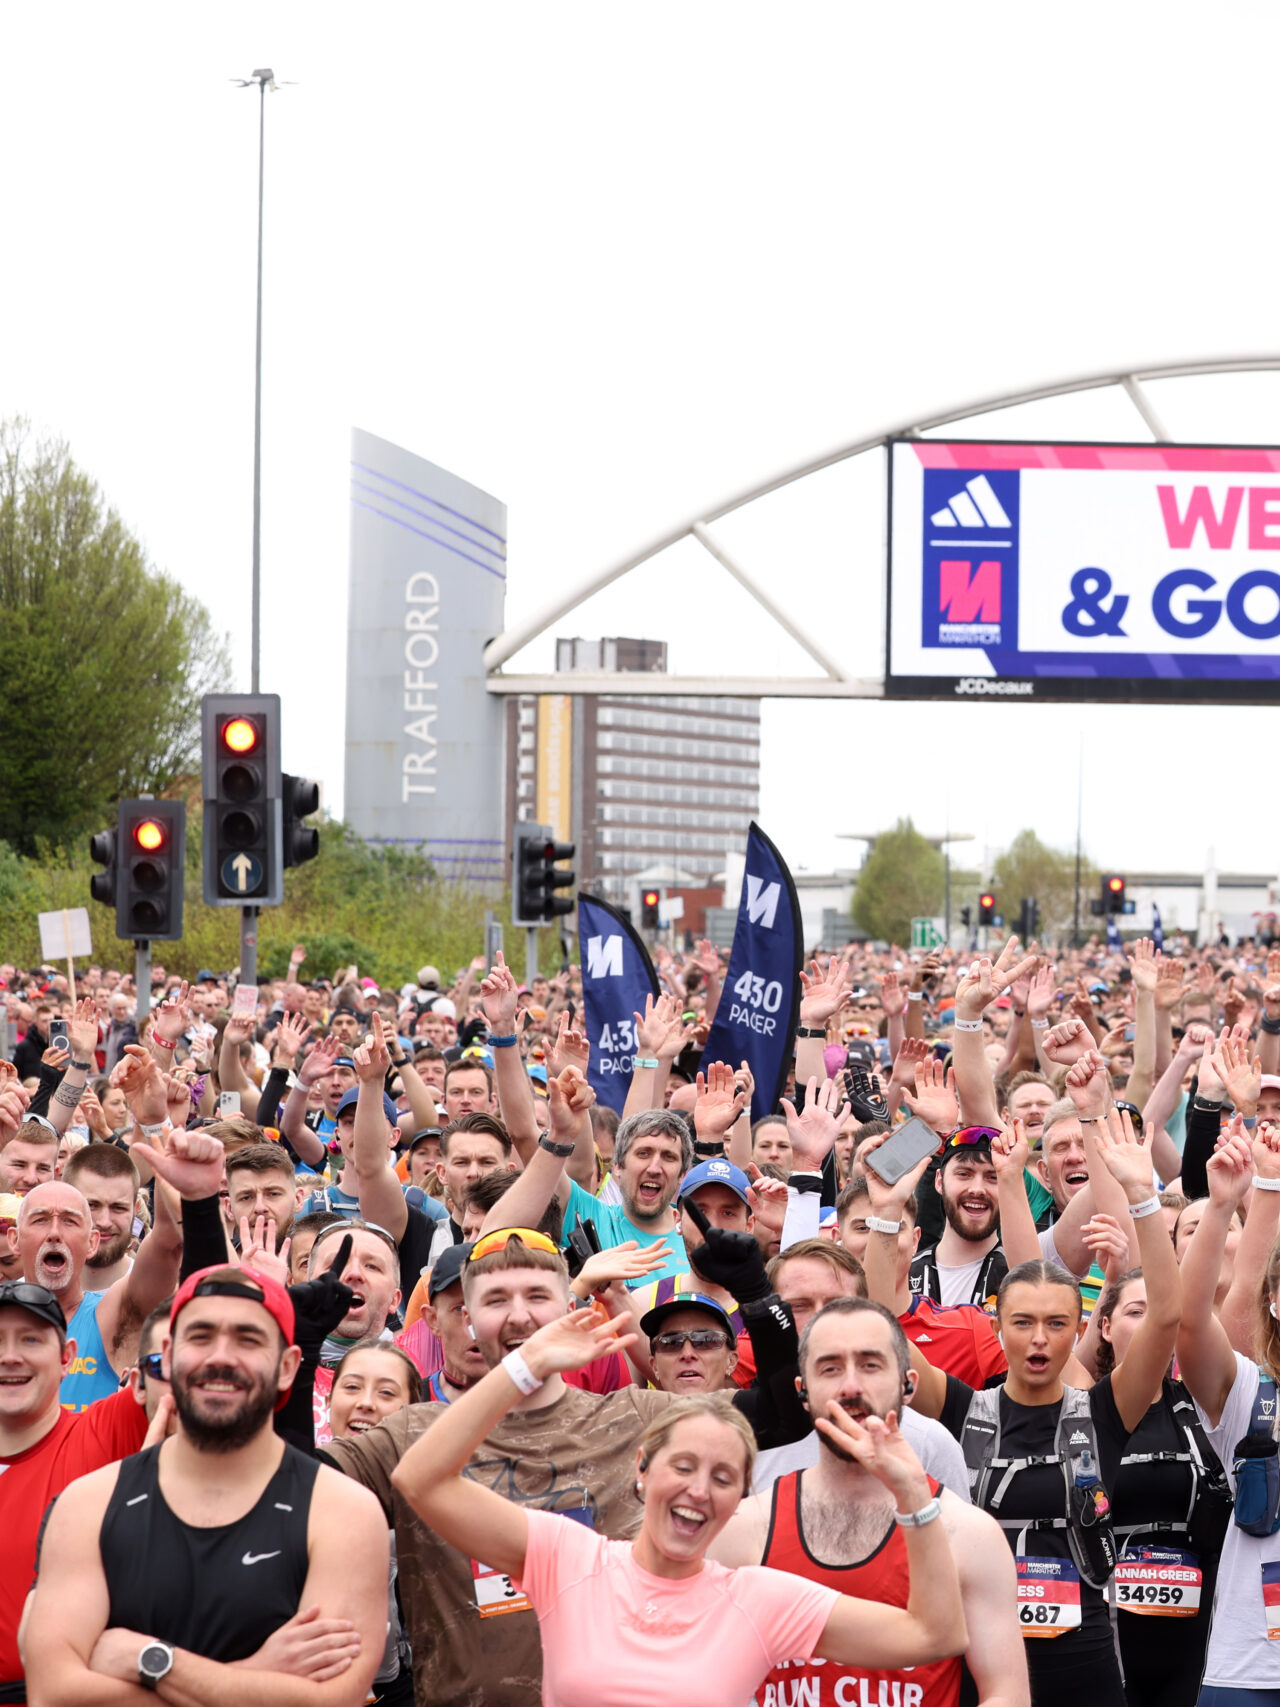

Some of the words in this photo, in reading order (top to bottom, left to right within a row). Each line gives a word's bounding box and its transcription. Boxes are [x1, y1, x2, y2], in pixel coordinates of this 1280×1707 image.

[1061, 567, 1129, 638] &
[402, 571, 440, 803] TRAFFORD
[955, 678, 1034, 695] JCDecaux
[734, 970, 783, 1013] 430
[728, 1003, 777, 1038] PACER
[769, 1305, 791, 1330] RUN
[1027, 1567, 1061, 1575] MARATHON
[1115, 1568, 1157, 1579] ANNAH
[1158, 1570, 1197, 1582] GREER
[1017, 1585, 1045, 1597] ESS
[1118, 1586, 1184, 1605] 34959
[1019, 1605, 1061, 1624] 687
